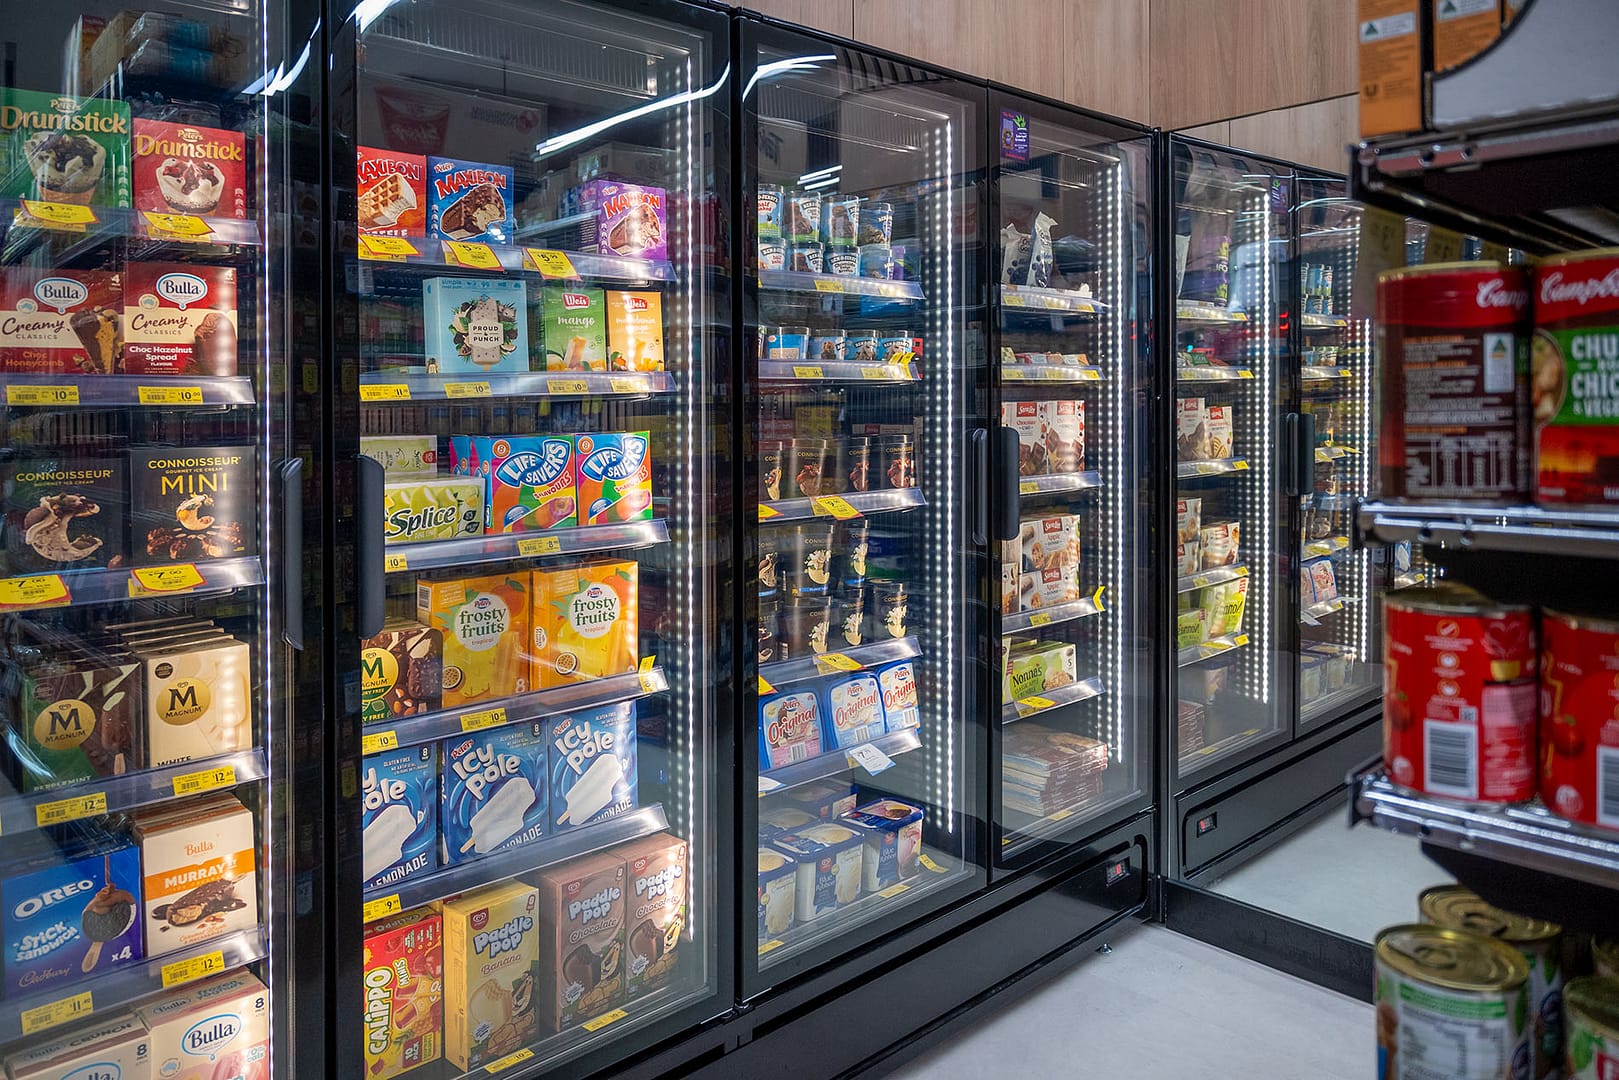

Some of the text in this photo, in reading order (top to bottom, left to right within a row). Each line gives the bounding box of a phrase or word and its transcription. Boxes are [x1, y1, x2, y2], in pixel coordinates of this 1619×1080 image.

[1, 104, 127, 135] Drumstick
[136, 134, 243, 162] Drumstick
[434, 168, 508, 201] MAXIBON
[43, 284, 81, 299] Bulla
[164, 279, 200, 295] Bulla
[565, 295, 588, 307] Weis
[625, 297, 647, 309] Weis
[2, 316, 65, 336] Creamy
[131, 313, 188, 332] Creamy
[558, 316, 595, 329] mango
[16, 333, 58, 341] CLASSICS
[22, 350, 48, 360] Choc
[129, 345, 152, 353] Choc
[145, 353, 177, 361] Spread
[5, 357, 64, 369] Honeycomb
[147, 456, 239, 470] CONNOISSEUR
[502, 454, 536, 481] LIFE
[525, 442, 568, 484] SAVERS
[587, 451, 618, 476] LIFE
[606, 438, 645, 478] SAVERS
[16, 469, 112, 482] CONNOISSEUR
[161, 472, 227, 496] MINI
[385, 507, 456, 537] Splice
[572, 594, 617, 614] frosty
[459, 605, 508, 626] frosty
[575, 609, 616, 627] fruits
[460, 622, 506, 640] fruits
[471, 637, 495, 646] tropical
[361, 657, 385, 679] M
[1012, 664, 1043, 686] Nonna's
[361, 678, 389, 689] AGNUM
[515, 678, 525, 695] 8
[167, 684, 199, 711] M
[165, 706, 202, 719] MAGNUM
[836, 689, 877, 727] Original
[49, 707, 82, 736] M
[767, 704, 817, 745] Original
[45, 730, 86, 743] MAGNUM
[400, 756, 411, 764] FREE
[186, 842, 215, 857] Bulla
[164, 863, 226, 890] MURRAY
[14, 879, 94, 919] OREO
[569, 917, 618, 945] Chocolate
[112, 945, 132, 963] x4
[480, 952, 522, 976] Banana
[19, 968, 71, 988] Cadbury
[394, 958, 409, 987] MINIS
[255, 997, 265, 1010] 8
[69, 1022, 133, 1049] CRUNCH
[189, 1022, 234, 1049] Bulla
[136, 1044, 148, 1056] 8
